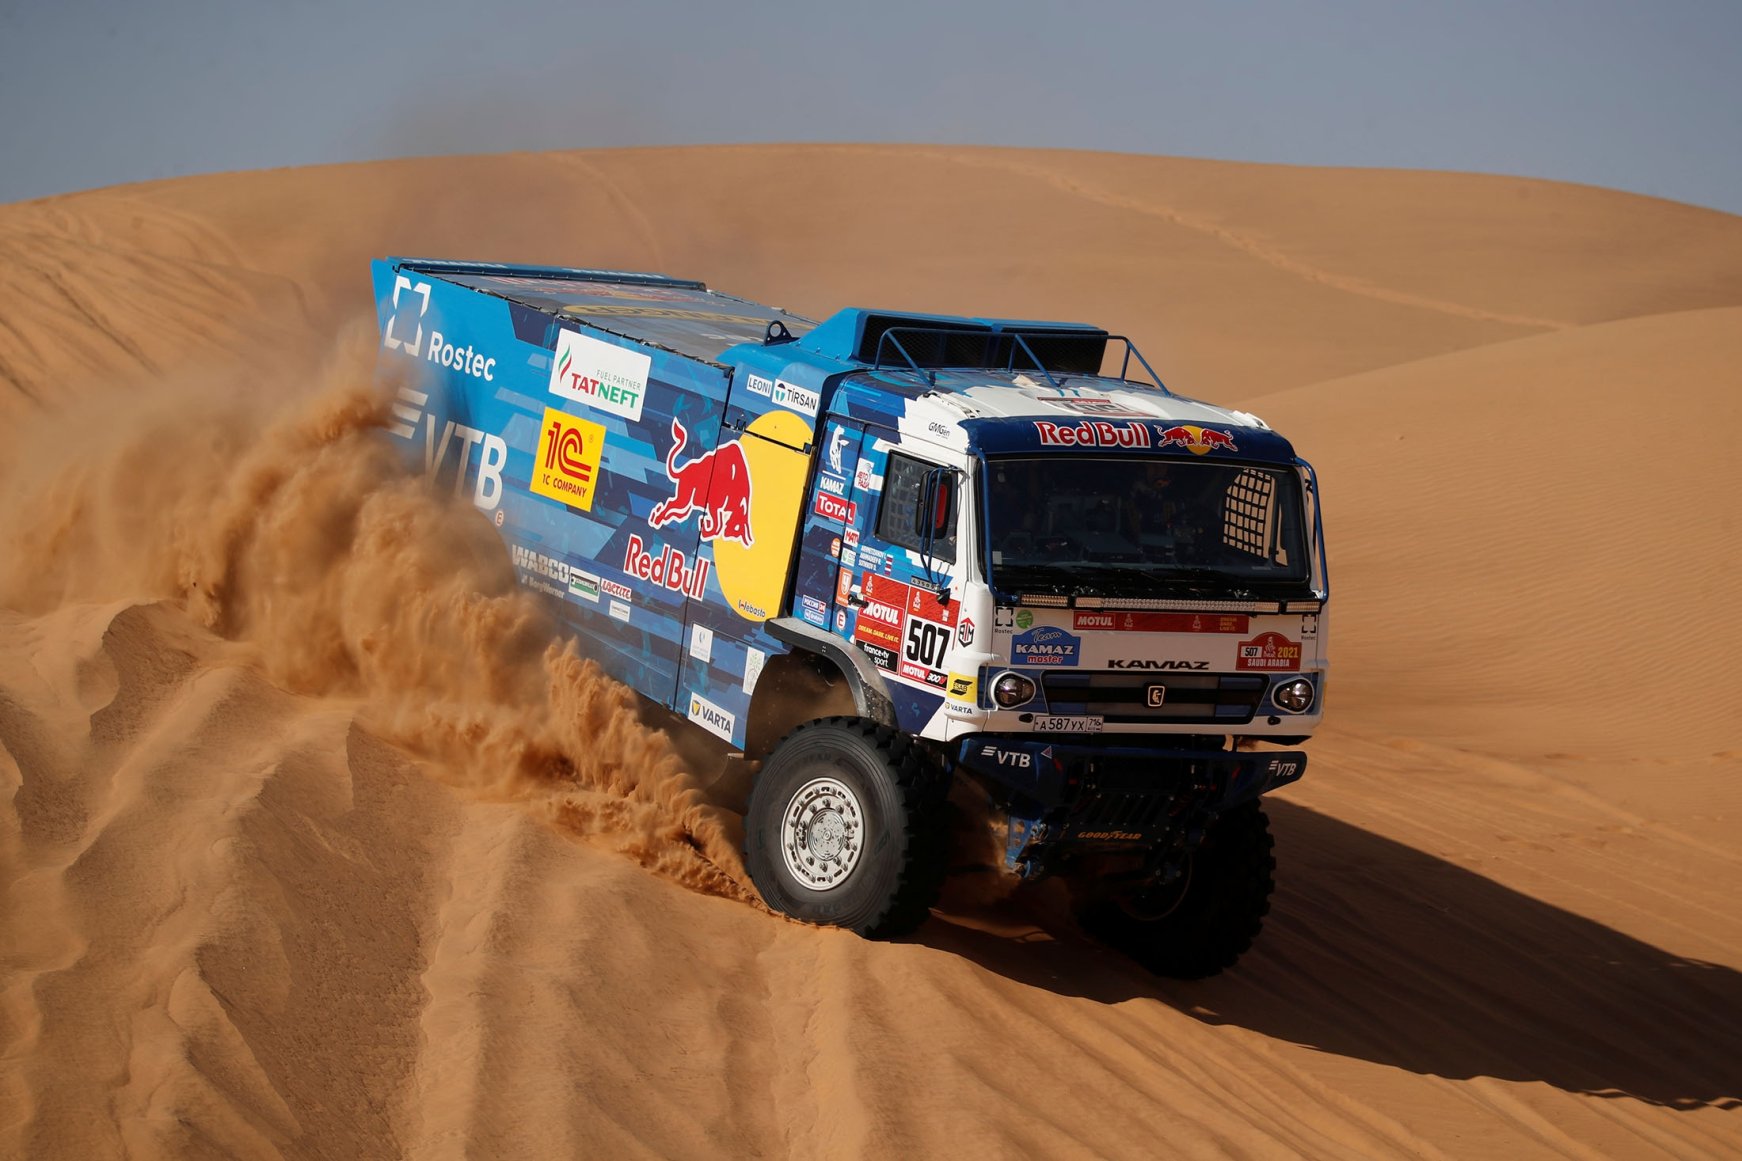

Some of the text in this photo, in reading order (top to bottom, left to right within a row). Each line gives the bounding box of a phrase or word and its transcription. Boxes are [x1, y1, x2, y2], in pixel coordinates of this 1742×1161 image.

[428, 331, 496, 381] Rostec
[597, 369, 641, 391] FUEL PARTNER
[749, 377, 771, 394] LEONI
[572, 373, 639, 408] TATNEFT
[1034, 421, 1151, 448] Red Bull
[425, 412, 507, 510] VTB
[553, 477, 588, 498] COMPANY
[820, 476, 844, 495] KAMAZ
[819, 495, 853, 520] TOTAL
[512, 545, 569, 583] WABCO
[623, 534, 710, 602] Red Bull
[602, 580, 631, 600] LOCTITE
[738, 599, 766, 618] Webasto
[863, 602, 899, 624] MOTUL
[1077, 617, 1113, 626] MOTUL
[907, 619, 950, 669] 507
[1031, 629, 1062, 643] Team
[1015, 644, 1074, 655] KAMAZ
[1245, 647, 1258, 656] 507
[1278, 647, 1298, 658] 2021
[874, 656, 888, 667] sport
[1027, 655, 1063, 664] master
[1108, 660, 1209, 670] KAMAZ
[1247, 658, 1289, 667] SAUDI ARABIA
[902, 664, 926, 679] MOTUL
[702, 701, 731, 734] VARTA
[951, 704, 972, 715] VARTA
[996, 750, 1031, 768] VTB
[1276, 763, 1297, 777] VTB
